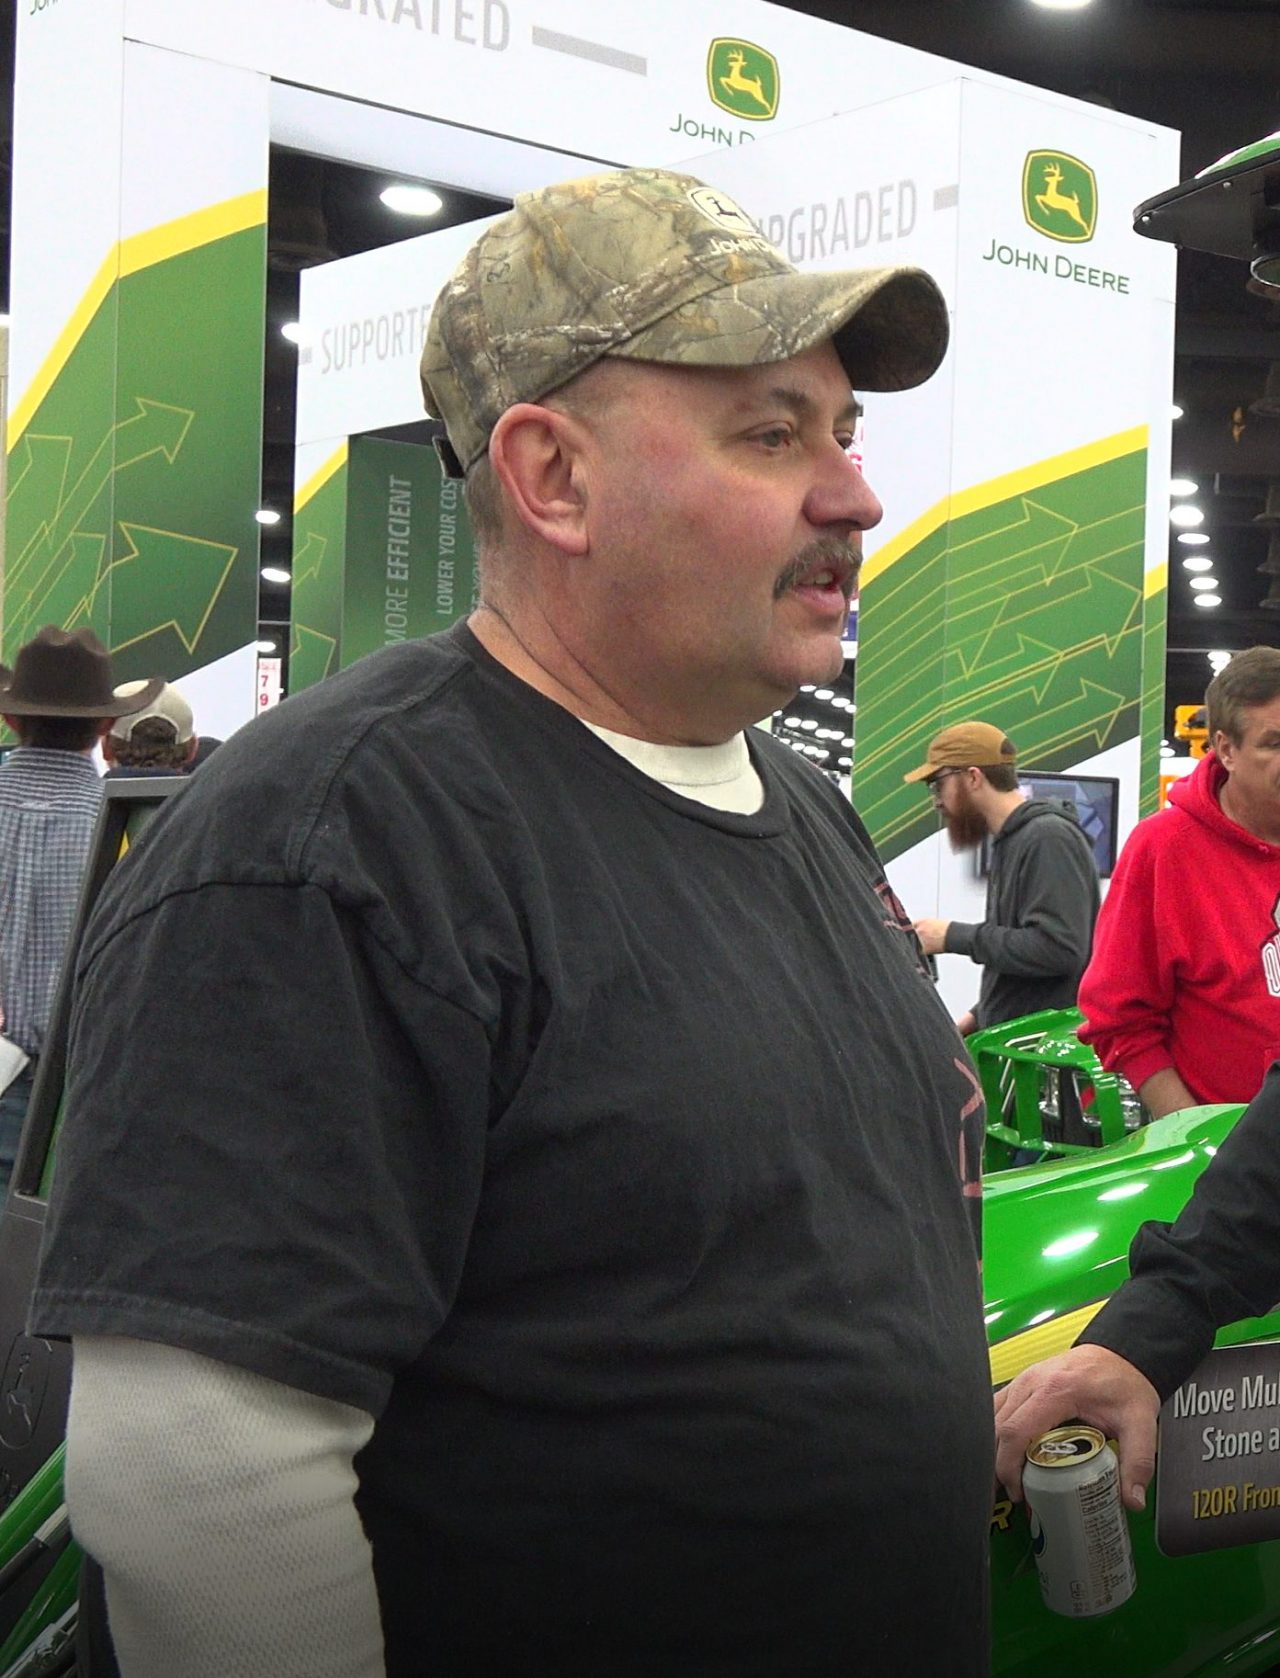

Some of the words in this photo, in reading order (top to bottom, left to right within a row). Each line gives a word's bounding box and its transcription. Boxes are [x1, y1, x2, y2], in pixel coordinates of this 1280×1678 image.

[669, 113, 732, 147] JOHN
[757, 178, 918, 264] PGRADED
[983, 238, 1048, 274] JOHN
[1055, 255, 1130, 295] DEERE
[441, 478, 458, 510] COS
[387, 474, 412, 580] EFFICIENT
[439, 513, 457, 555] YOUR
[437, 559, 455, 614] LOWER
[385, 586, 409, 645] MORE
[1173, 1383, 1235, 1418] Move
[1201, 1427, 1263, 1461] Stone
[1192, 1485, 1237, 1519] 120R
